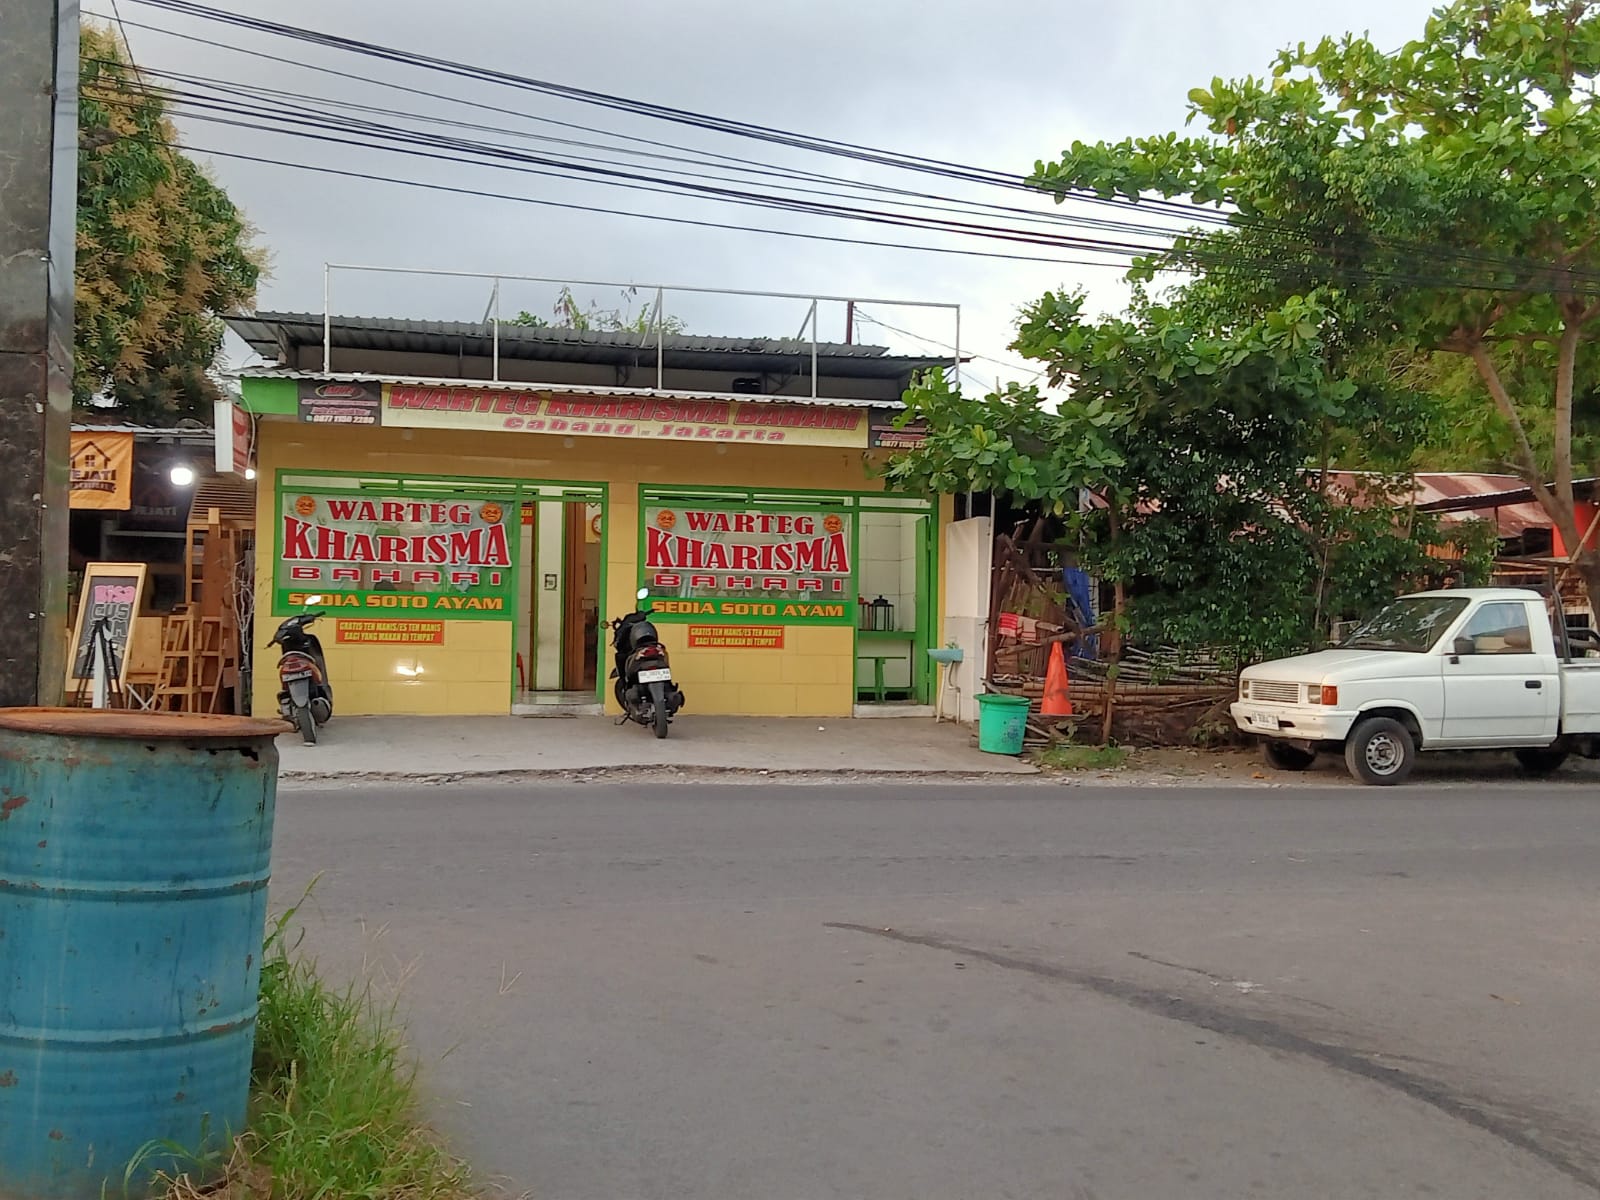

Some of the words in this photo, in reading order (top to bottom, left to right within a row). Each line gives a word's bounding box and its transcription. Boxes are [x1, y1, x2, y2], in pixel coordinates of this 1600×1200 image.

[388, 386, 541, 414] WARTEG
[545, 393, 730, 424] KHARISMA
[734, 404, 862, 430] BAHARI
[657, 424, 786, 440] Jakarta
[70, 468, 117, 481] EJATI
[326, 499, 473, 525] WARTEG
[685, 511, 815, 536] WARTEG
[282, 514, 512, 567] KHARISMA
[645, 526, 850, 574] KHARISMA
[291, 566, 502, 585] BAHARI
[653, 573, 842, 592] BAHARI
[365, 595, 429, 609] SOTO
[434, 598, 503, 610] AYAM
[651, 601, 716, 614] SEDIA
[721, 603, 777, 616] SOTO
[781, 604, 844, 617] AYAM
